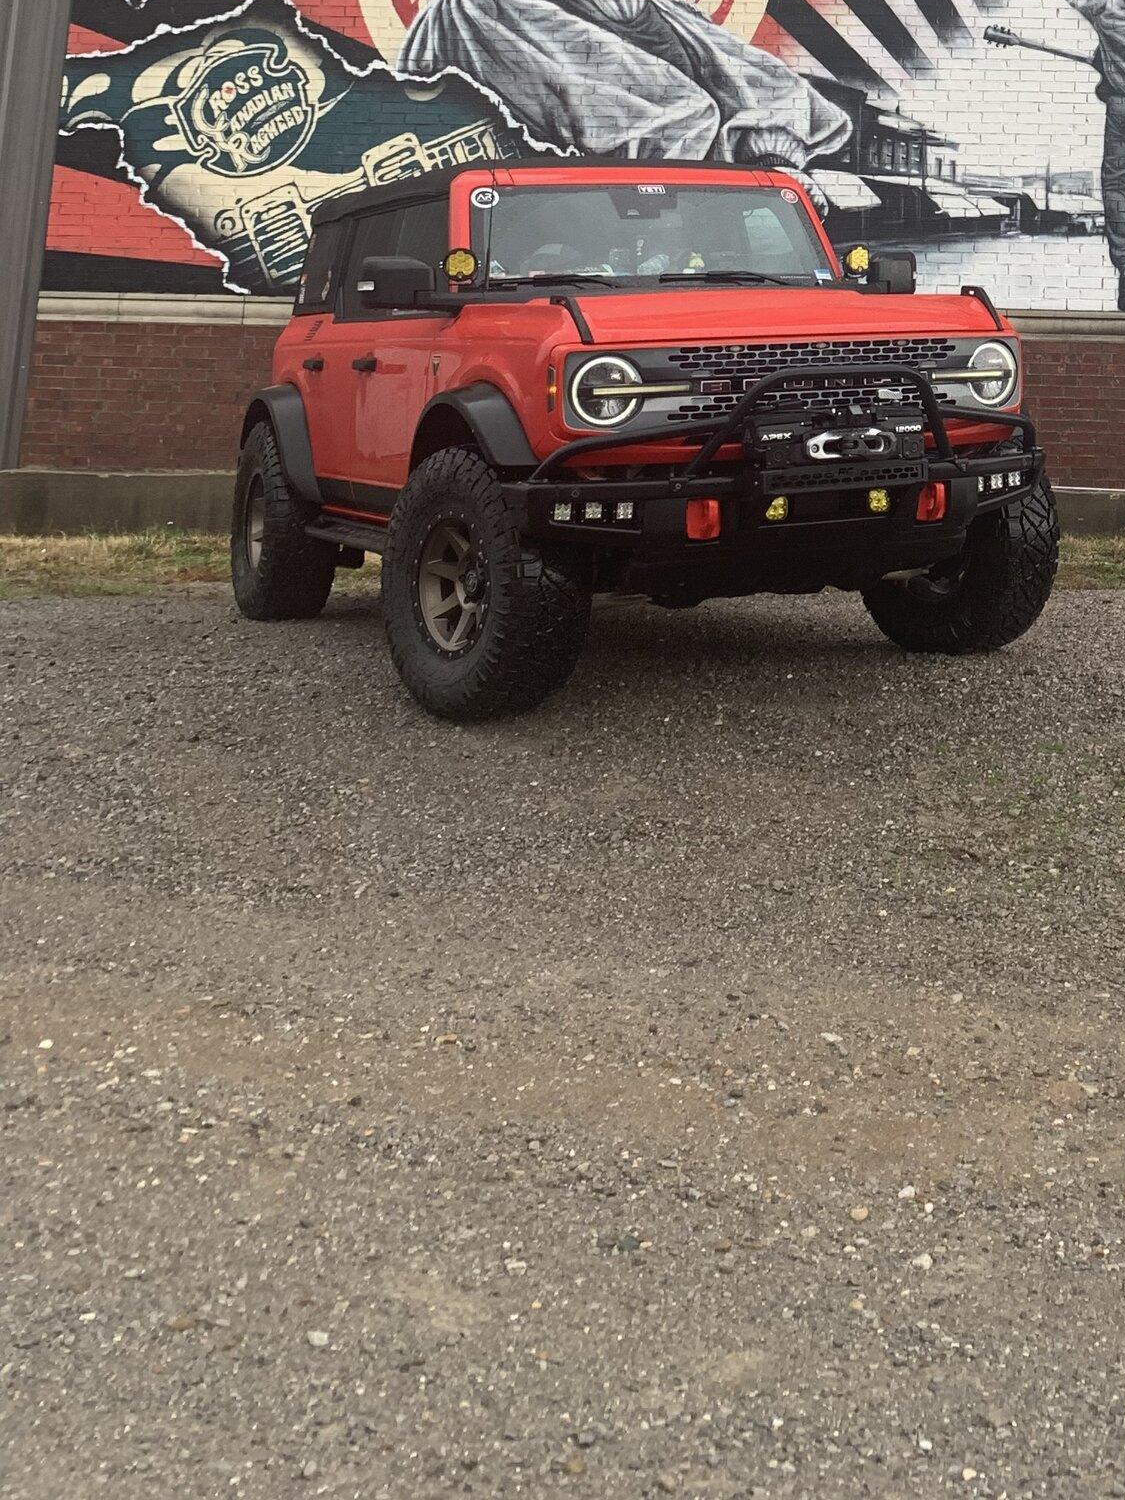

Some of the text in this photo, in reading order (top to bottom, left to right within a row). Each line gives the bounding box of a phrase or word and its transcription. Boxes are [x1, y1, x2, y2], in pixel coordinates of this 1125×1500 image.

[191, 65, 264, 135] CROSS
[217, 81, 296, 150] CANADIAN
[227, 105, 305, 174] RAGWEED
[639, 185, 664, 193] YETI
[760, 431, 793, 442] APEX
[895, 424, 922, 434] 12000
